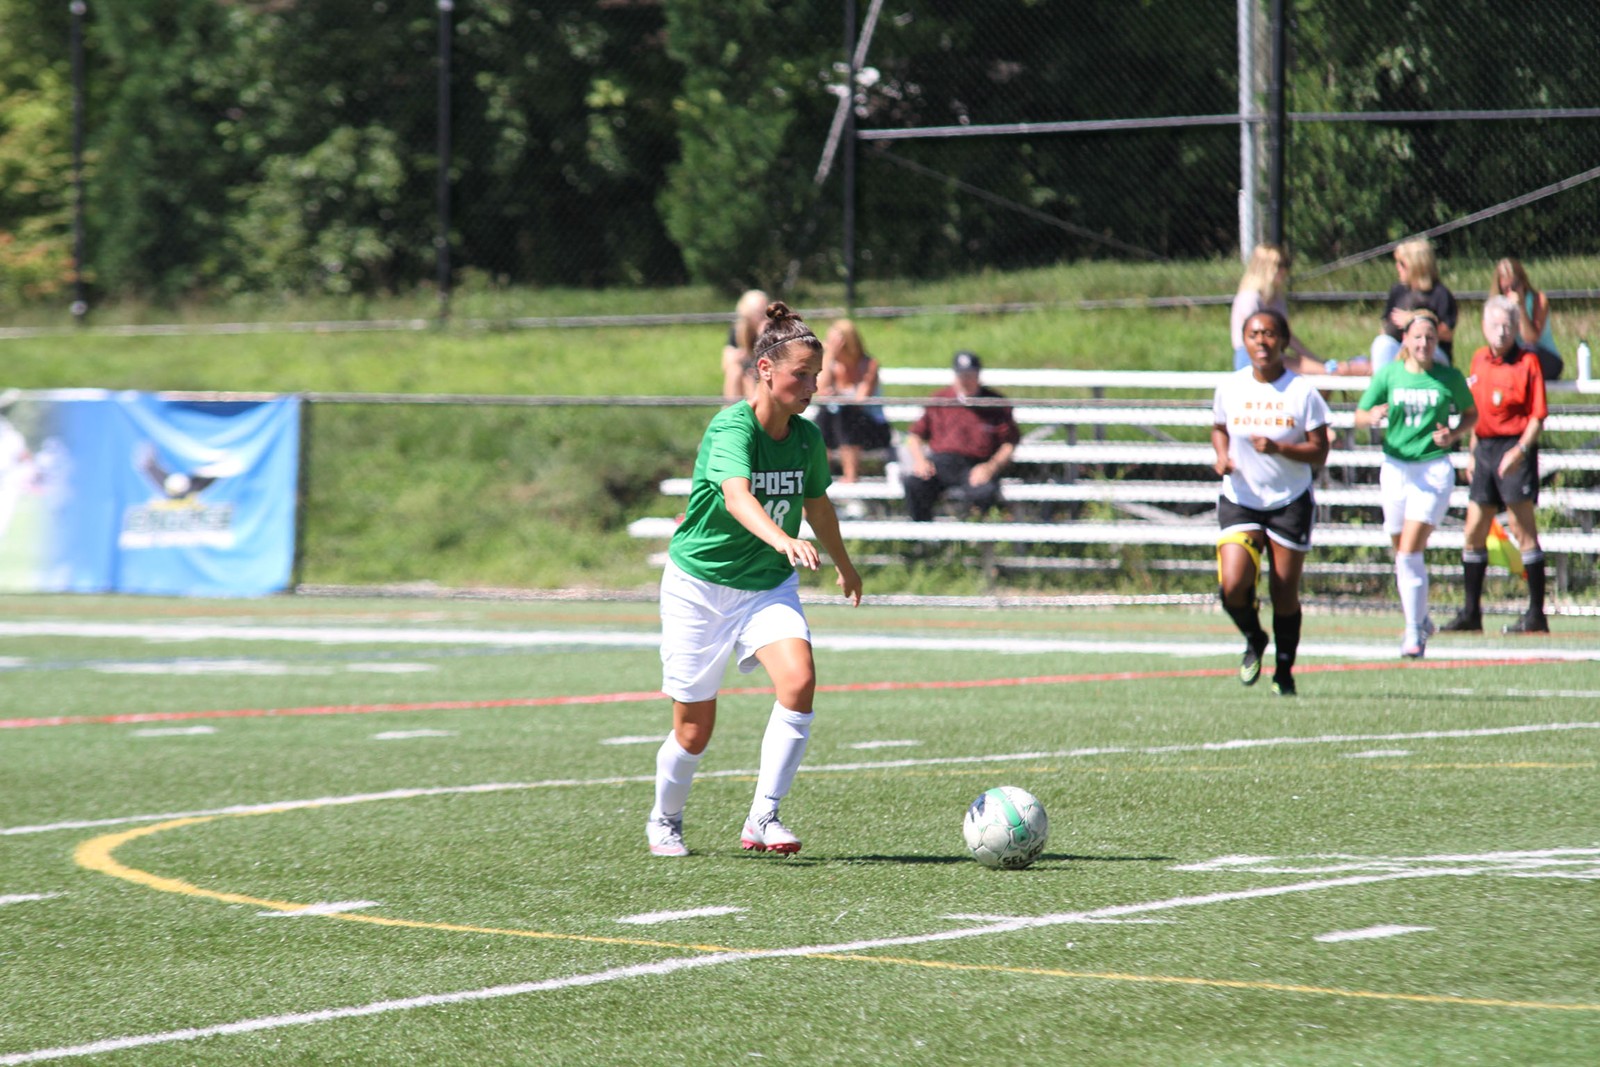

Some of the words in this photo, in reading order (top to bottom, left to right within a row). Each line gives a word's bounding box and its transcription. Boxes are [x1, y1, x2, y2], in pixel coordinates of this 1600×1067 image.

[1244, 401, 1284, 411] STAC
[1393, 388, 1440, 407] POST
[1233, 415, 1295, 429] SOCCER
[751, 470, 804, 496] POST
[763, 499, 791, 528] 18
